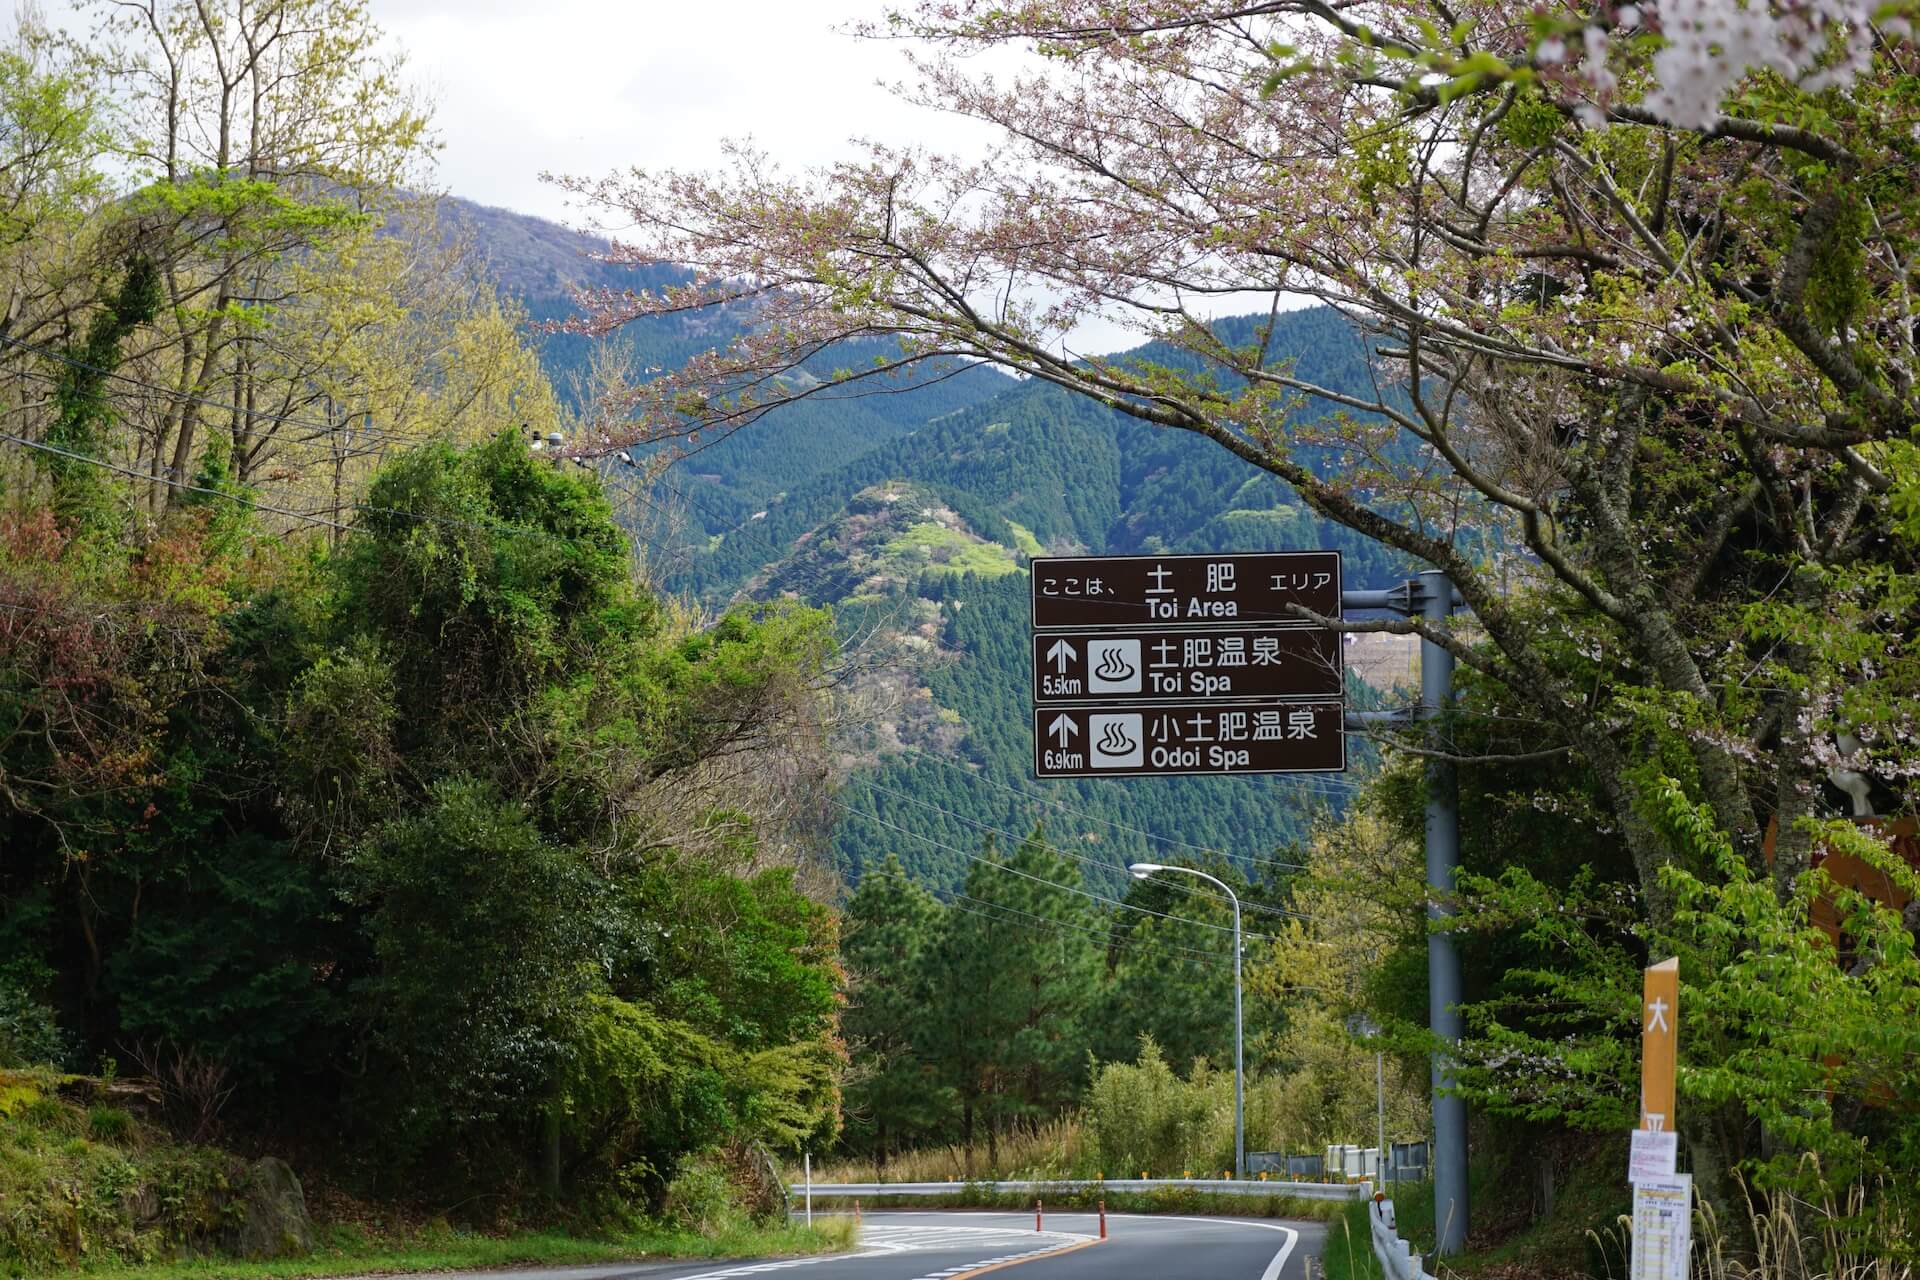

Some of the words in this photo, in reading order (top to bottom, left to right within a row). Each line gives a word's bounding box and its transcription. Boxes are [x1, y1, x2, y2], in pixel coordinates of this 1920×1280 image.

[1270, 573, 1331, 591] エリア
[1145, 597, 1178, 618] Toi
[1187, 597, 1238, 618] Area
[1149, 637, 1282, 668] 土肥温泉
[1043, 674, 1081, 695] 5.5km
[1149, 672, 1182, 693] Toi
[1190, 673, 1231, 696] Spa
[1151, 711, 1318, 742] 小土肥温泉
[1044, 749, 1083, 770] 6.9km
[1151, 746, 1200, 768] Odoi
[1208, 748, 1250, 770] Spa
